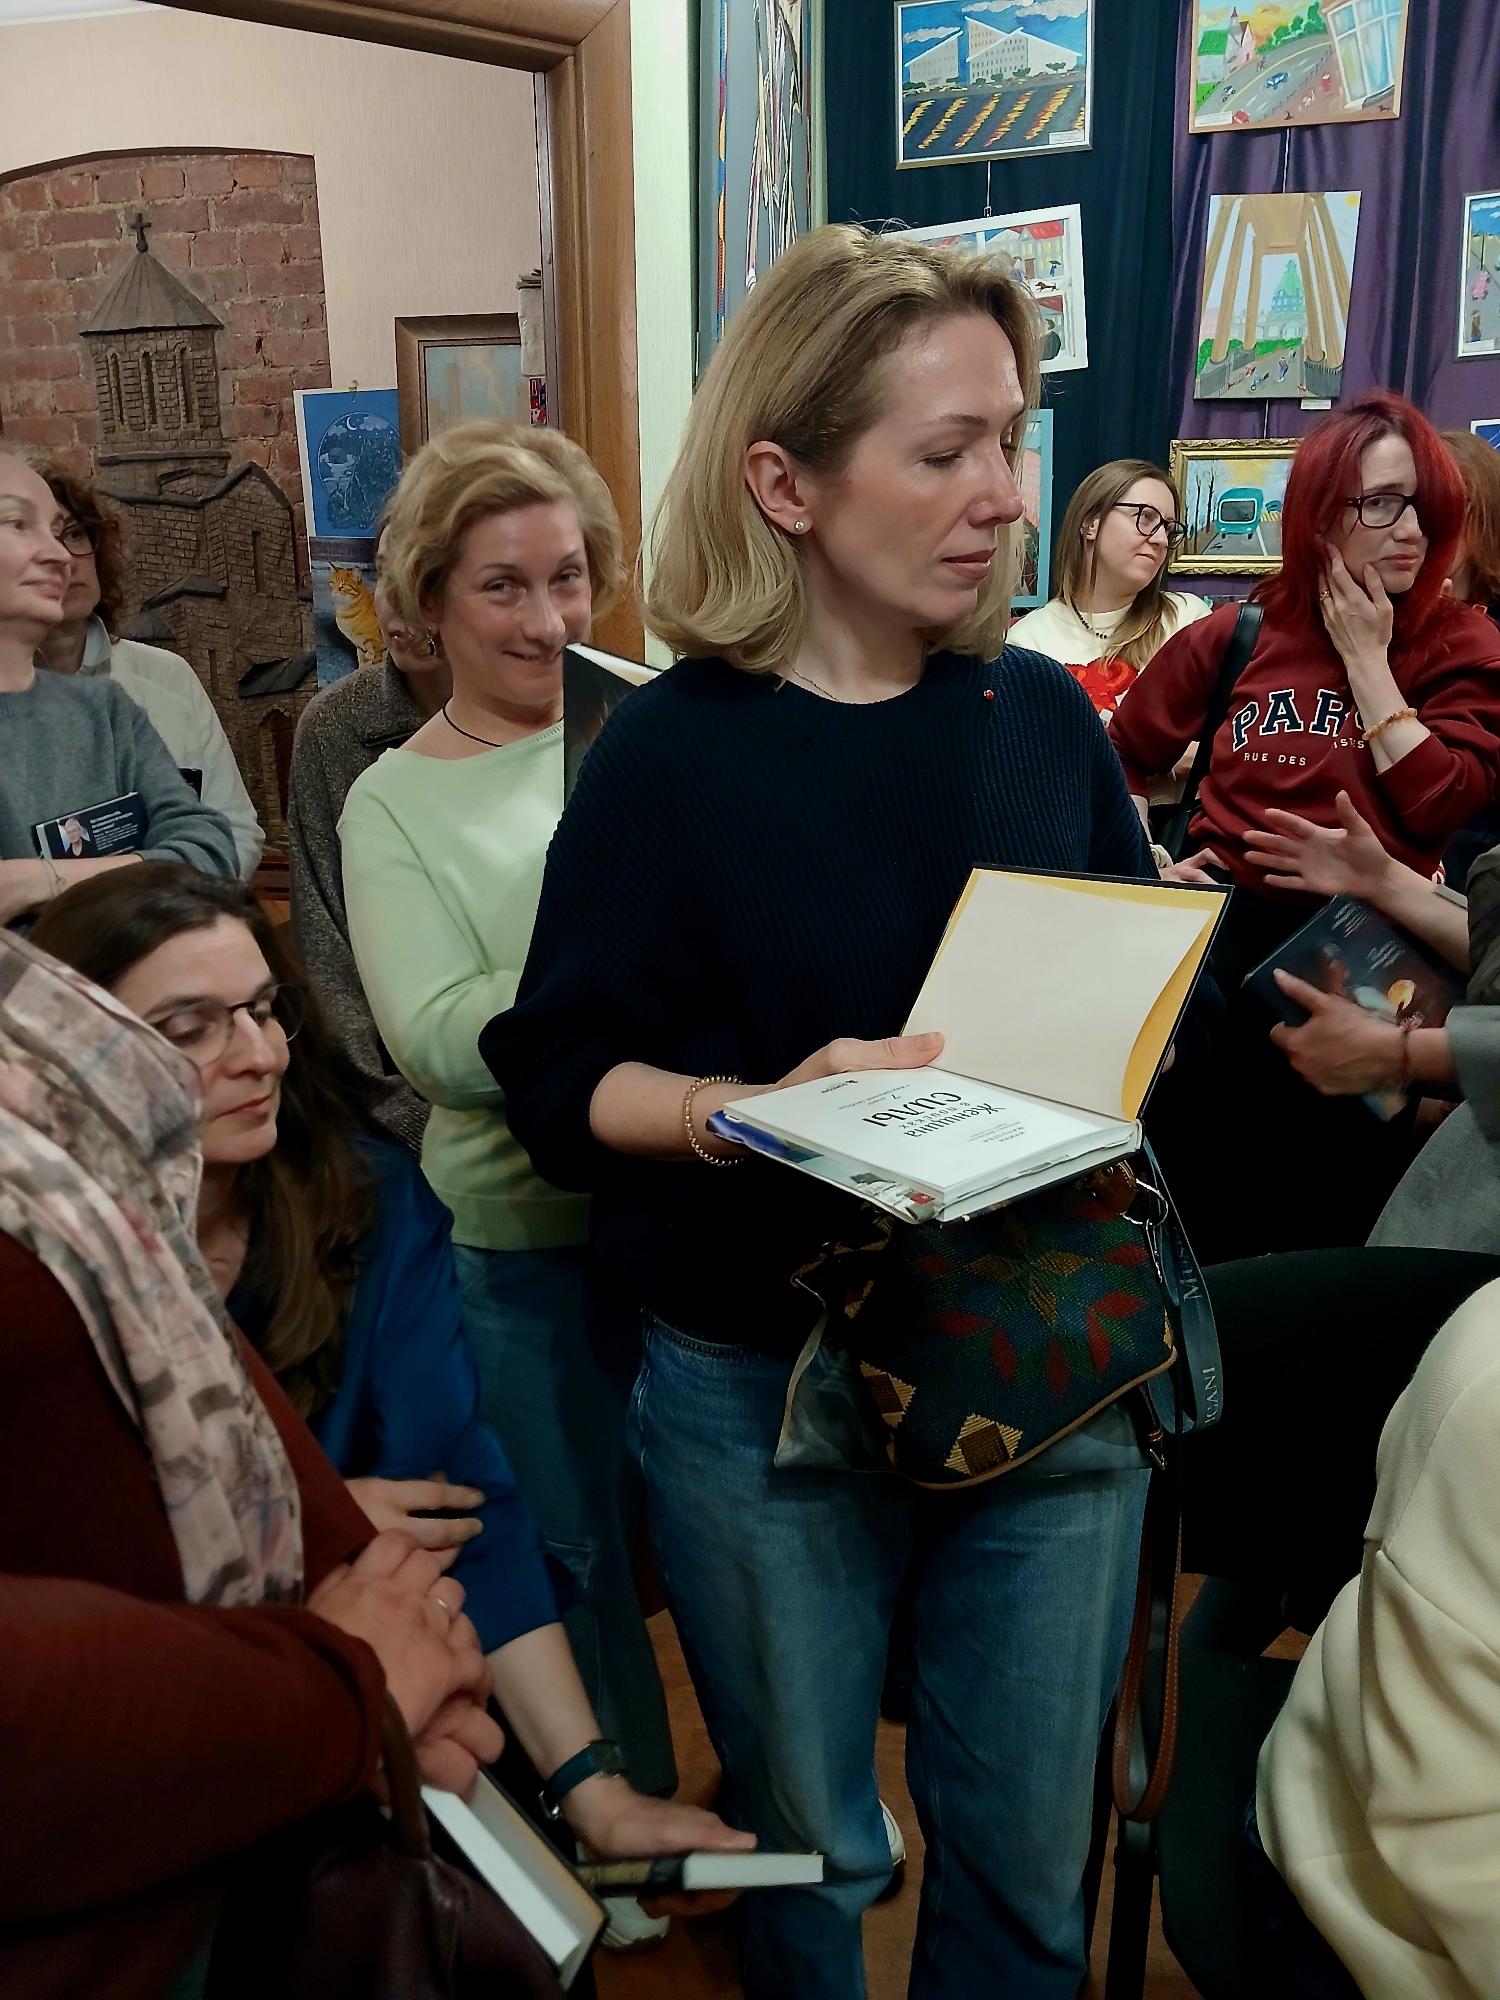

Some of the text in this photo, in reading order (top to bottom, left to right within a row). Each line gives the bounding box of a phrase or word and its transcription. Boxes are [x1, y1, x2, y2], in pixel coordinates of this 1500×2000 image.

[1243, 752, 1269, 762] RUE
[1277, 754, 1307, 766] DES
[904, 1103, 1005, 1137] Женщина
